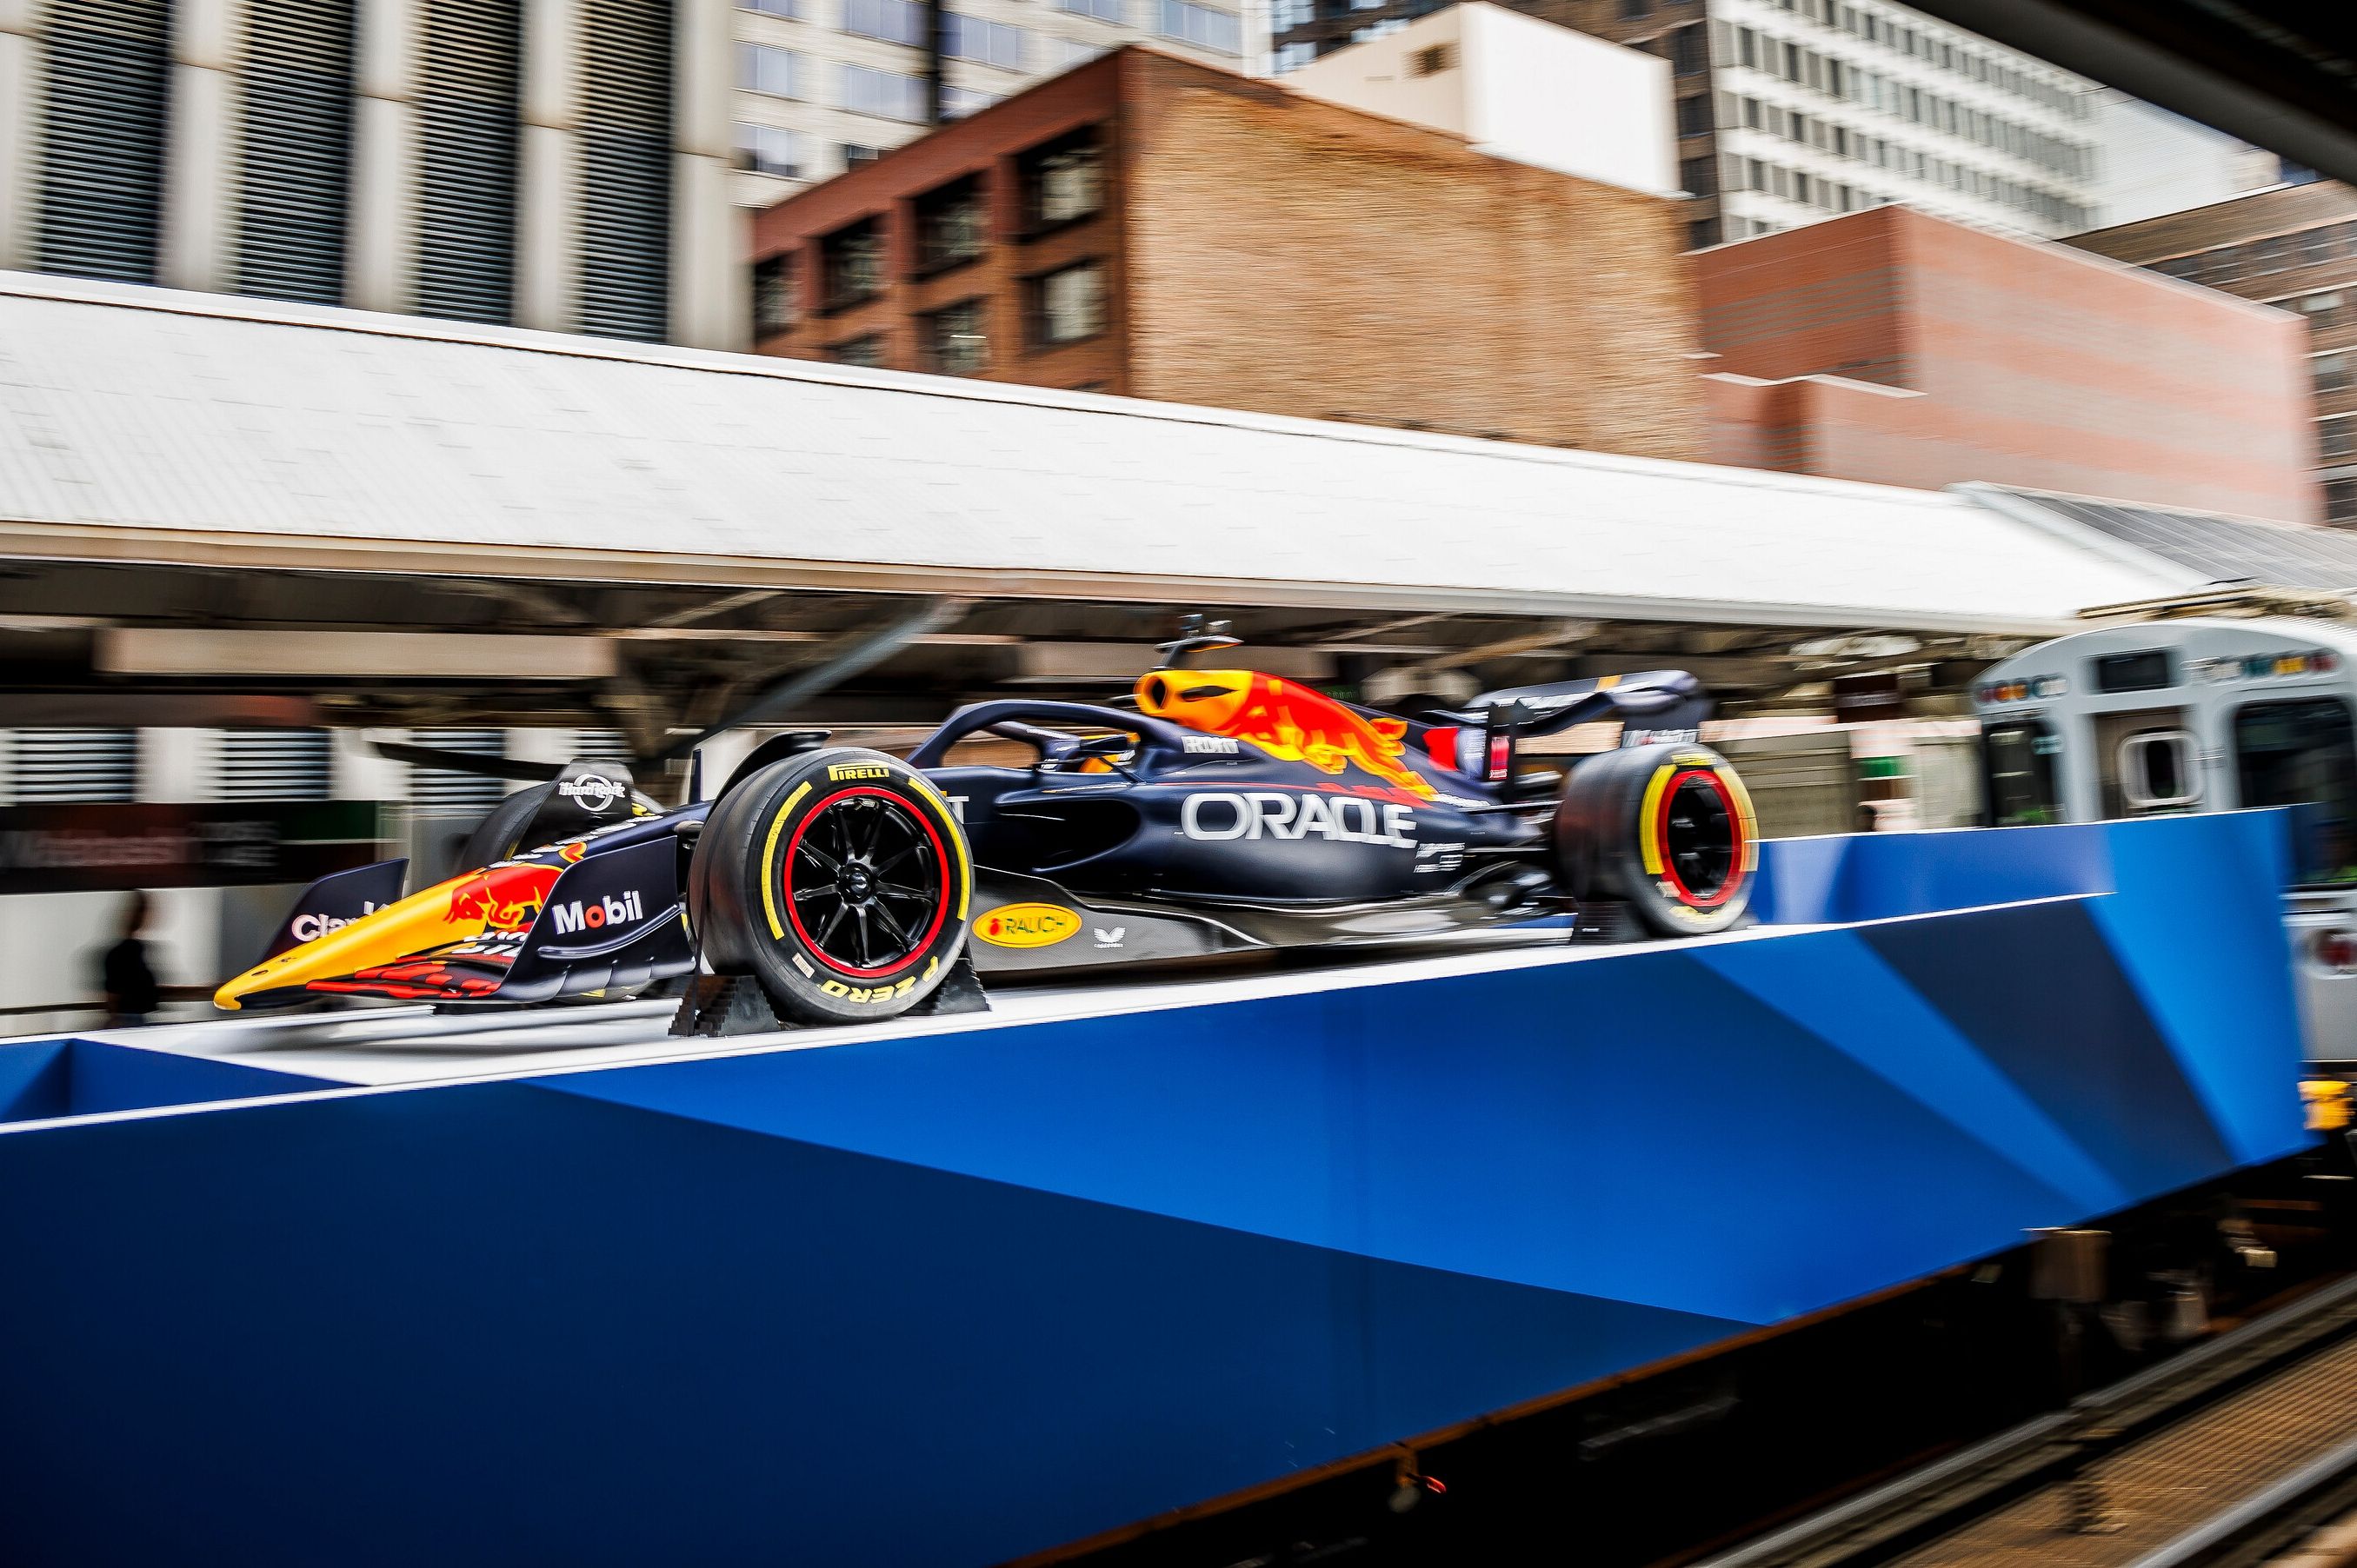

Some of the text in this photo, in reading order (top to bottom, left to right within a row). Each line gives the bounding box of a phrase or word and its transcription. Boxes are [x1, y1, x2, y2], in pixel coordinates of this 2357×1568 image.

[827, 761, 891, 781] PIRELLI
[1181, 792, 1418, 849] ORACLE
[552, 890, 643, 935] Mobil
[1005, 916, 1068, 934] RAUCH
[818, 955, 940, 1005] P ZERO
